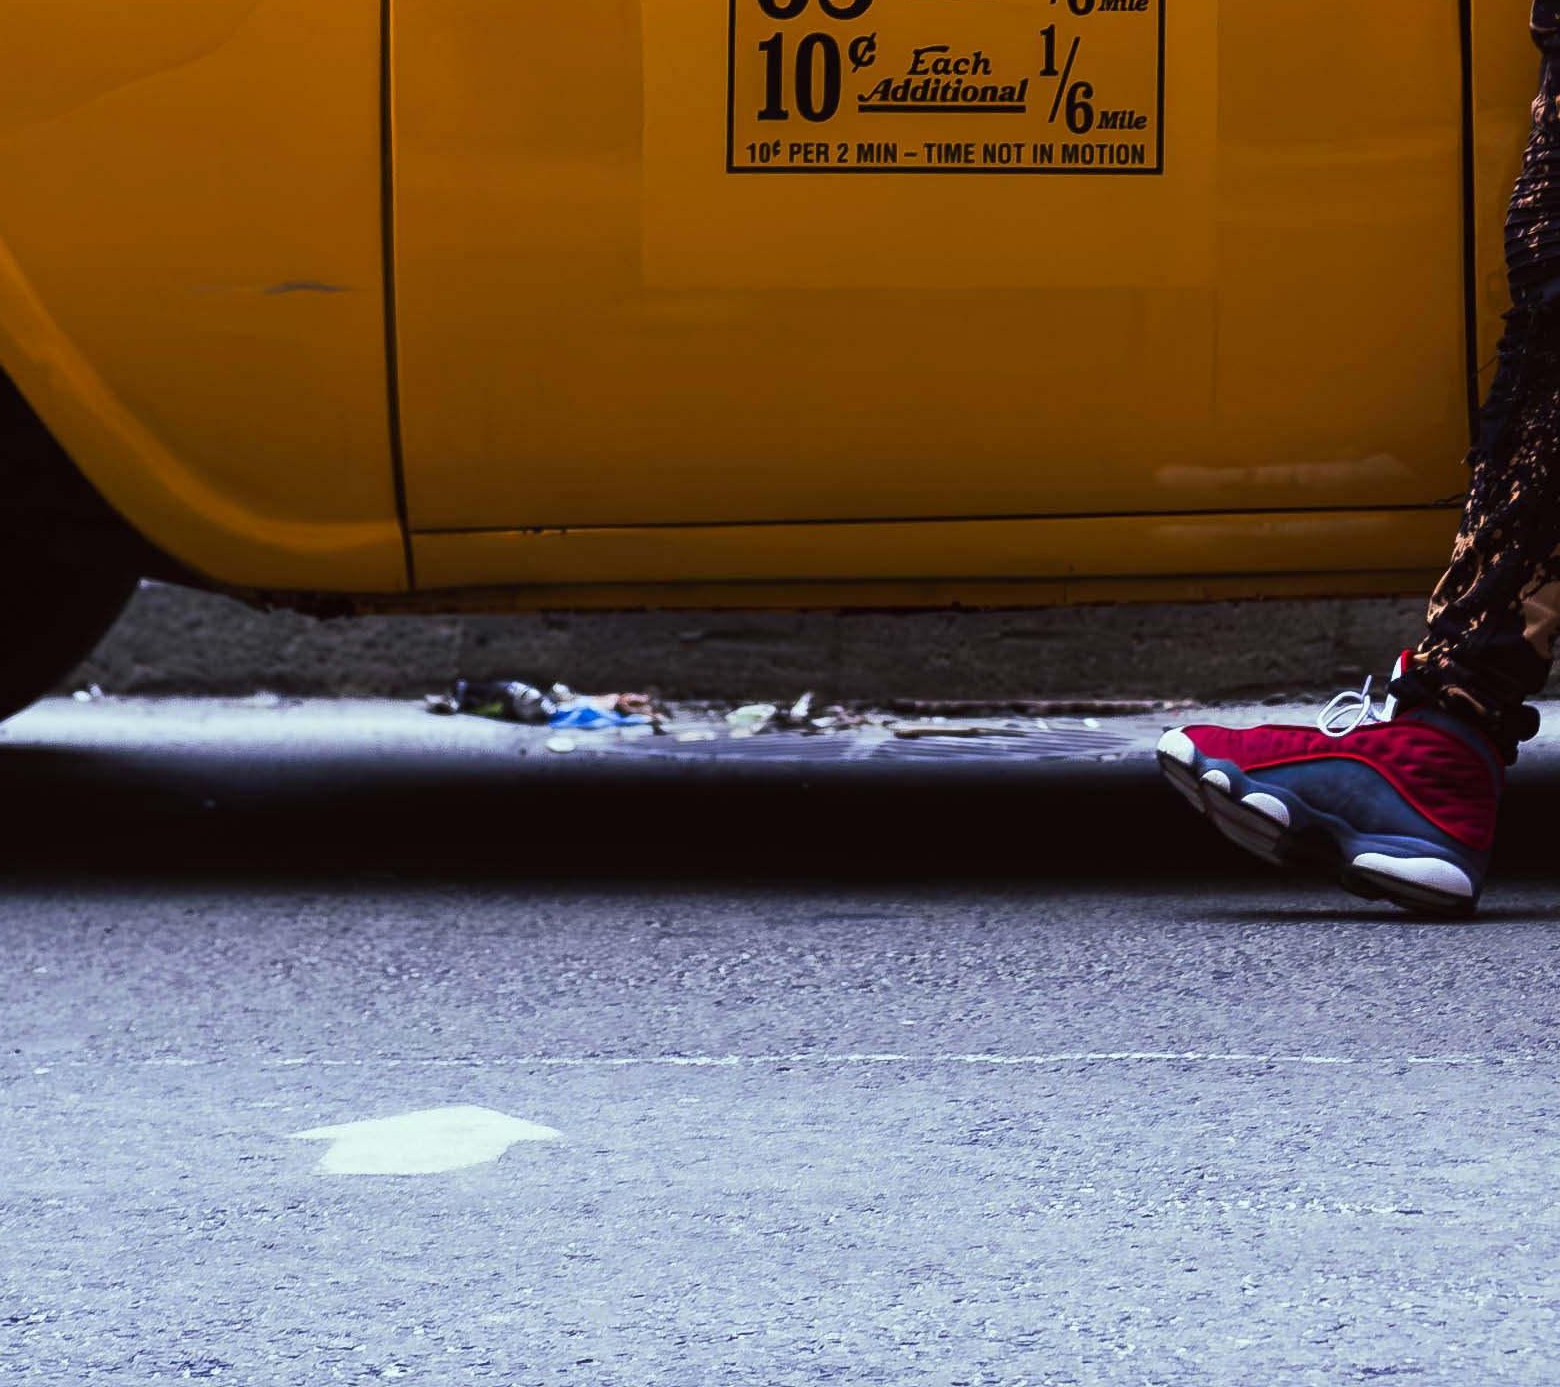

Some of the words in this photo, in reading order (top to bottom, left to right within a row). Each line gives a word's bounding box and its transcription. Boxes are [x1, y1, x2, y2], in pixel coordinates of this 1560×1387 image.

[906, 45, 993, 76] Each
[756, 31, 878, 123] 10¢
[857, 77, 1029, 103] Additional
[1038, 23, 1095, 135] 1/6
[1095, 110, 1148, 131] Mile
[746, 139, 782, 164] 10¢
[788, 142, 830, 164] PER
[836, 142, 850, 164] 2
[856, 142, 899, 164] MIN
[923, 142, 976, 165] TIME
[982, 143, 1027, 165] NOT
[1031, 143, 1055, 166] IN
[1061, 143, 1146, 166] MOTION
